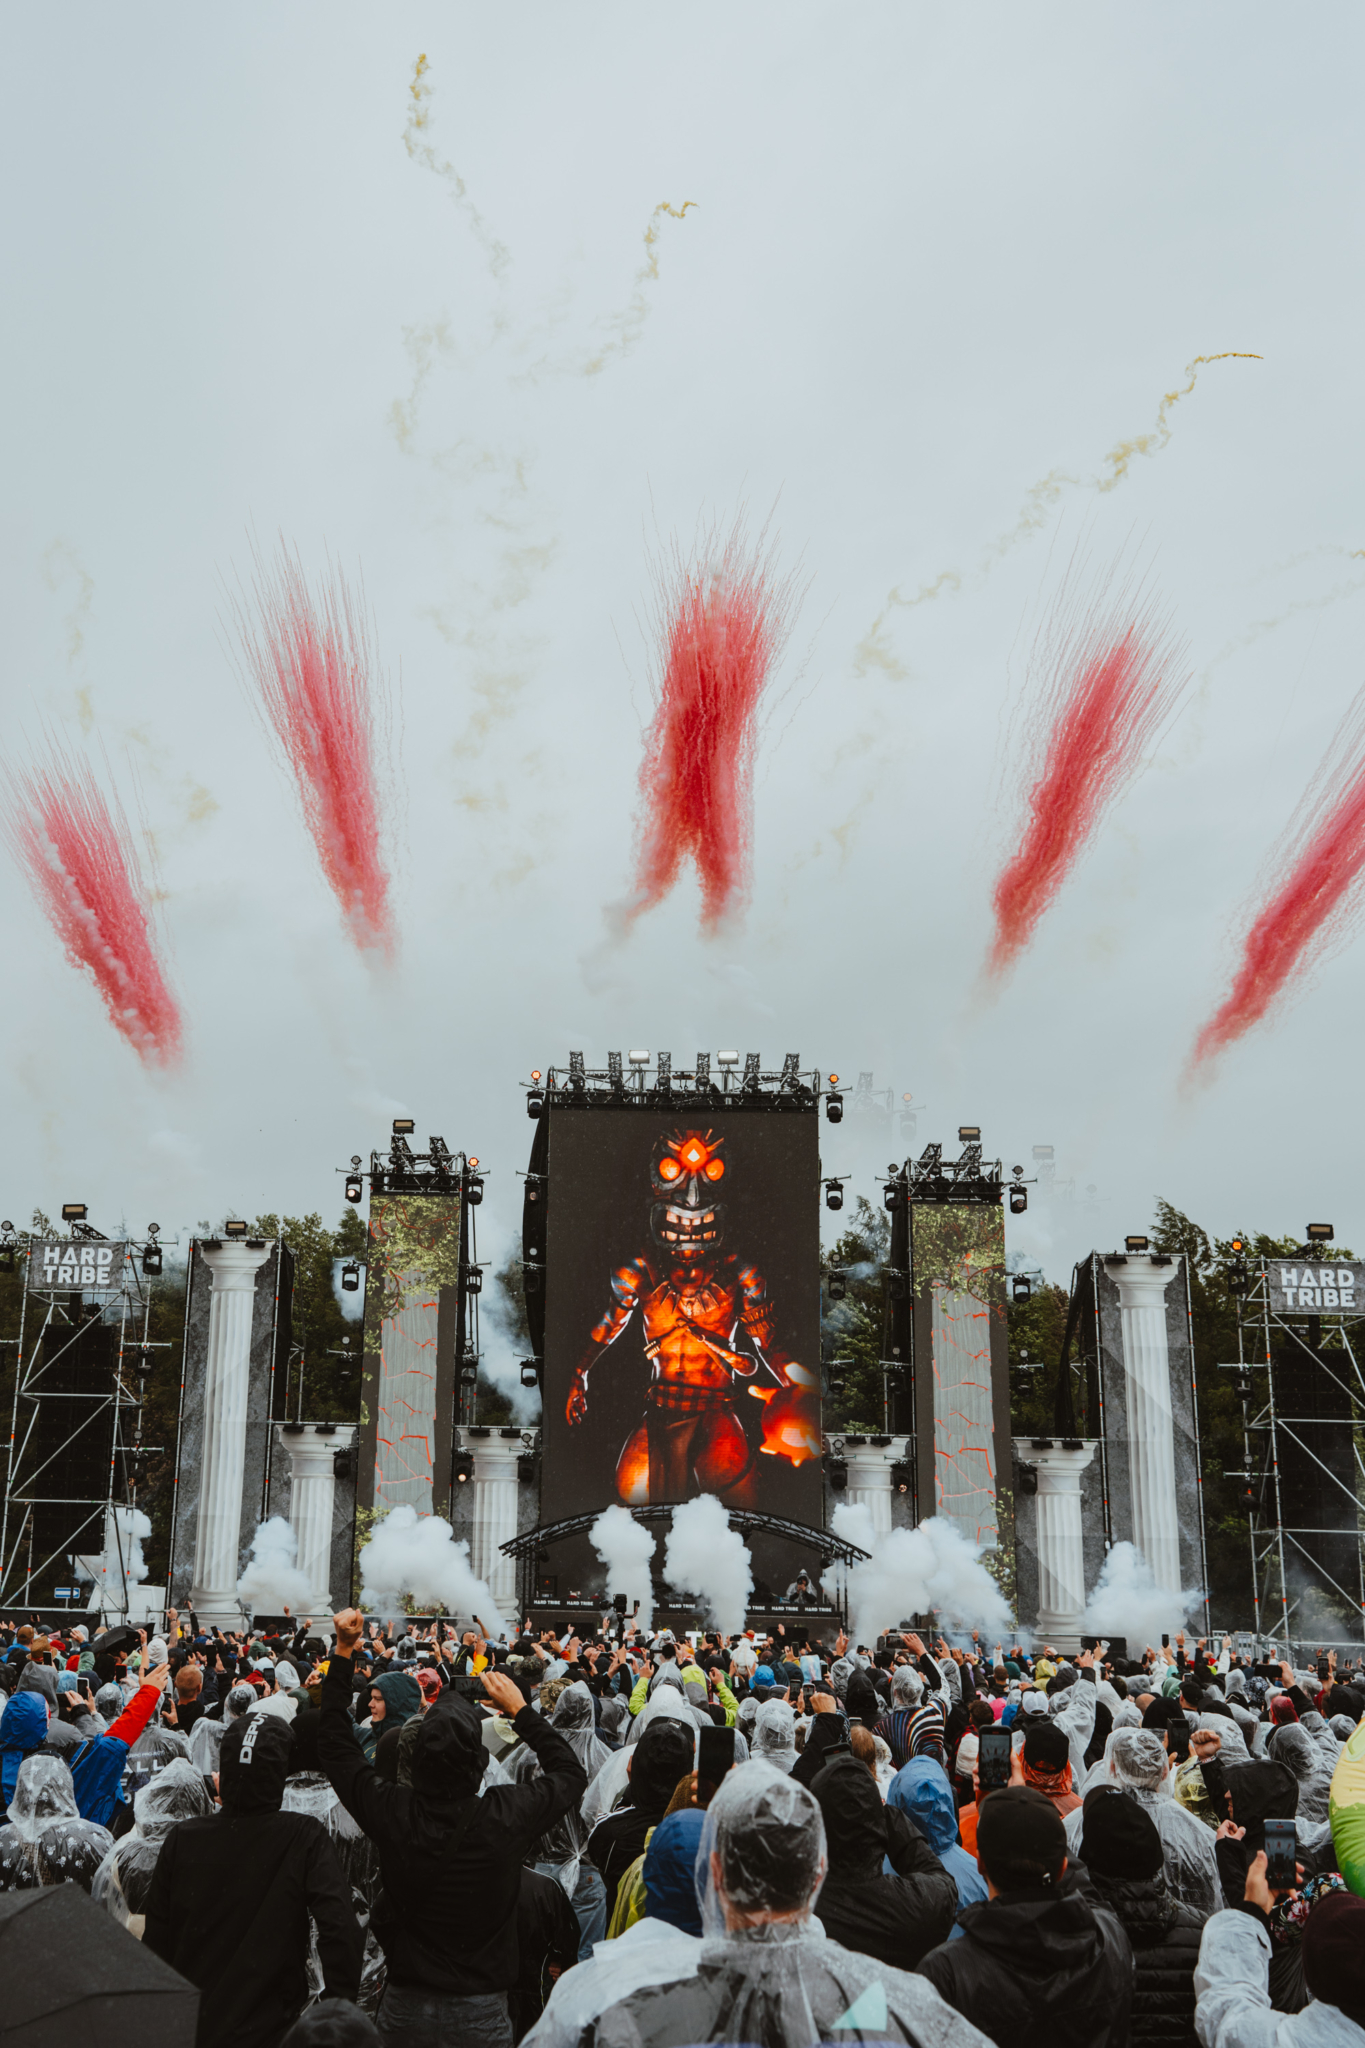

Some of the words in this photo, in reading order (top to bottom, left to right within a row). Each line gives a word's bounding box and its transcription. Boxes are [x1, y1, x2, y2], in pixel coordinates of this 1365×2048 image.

[43, 1246, 113, 1265] HARD
[43, 1265, 111, 1284] TRIBE
[1281, 1268, 1355, 1287] HARD
[1282, 1287, 1355, 1307] TRIBE
